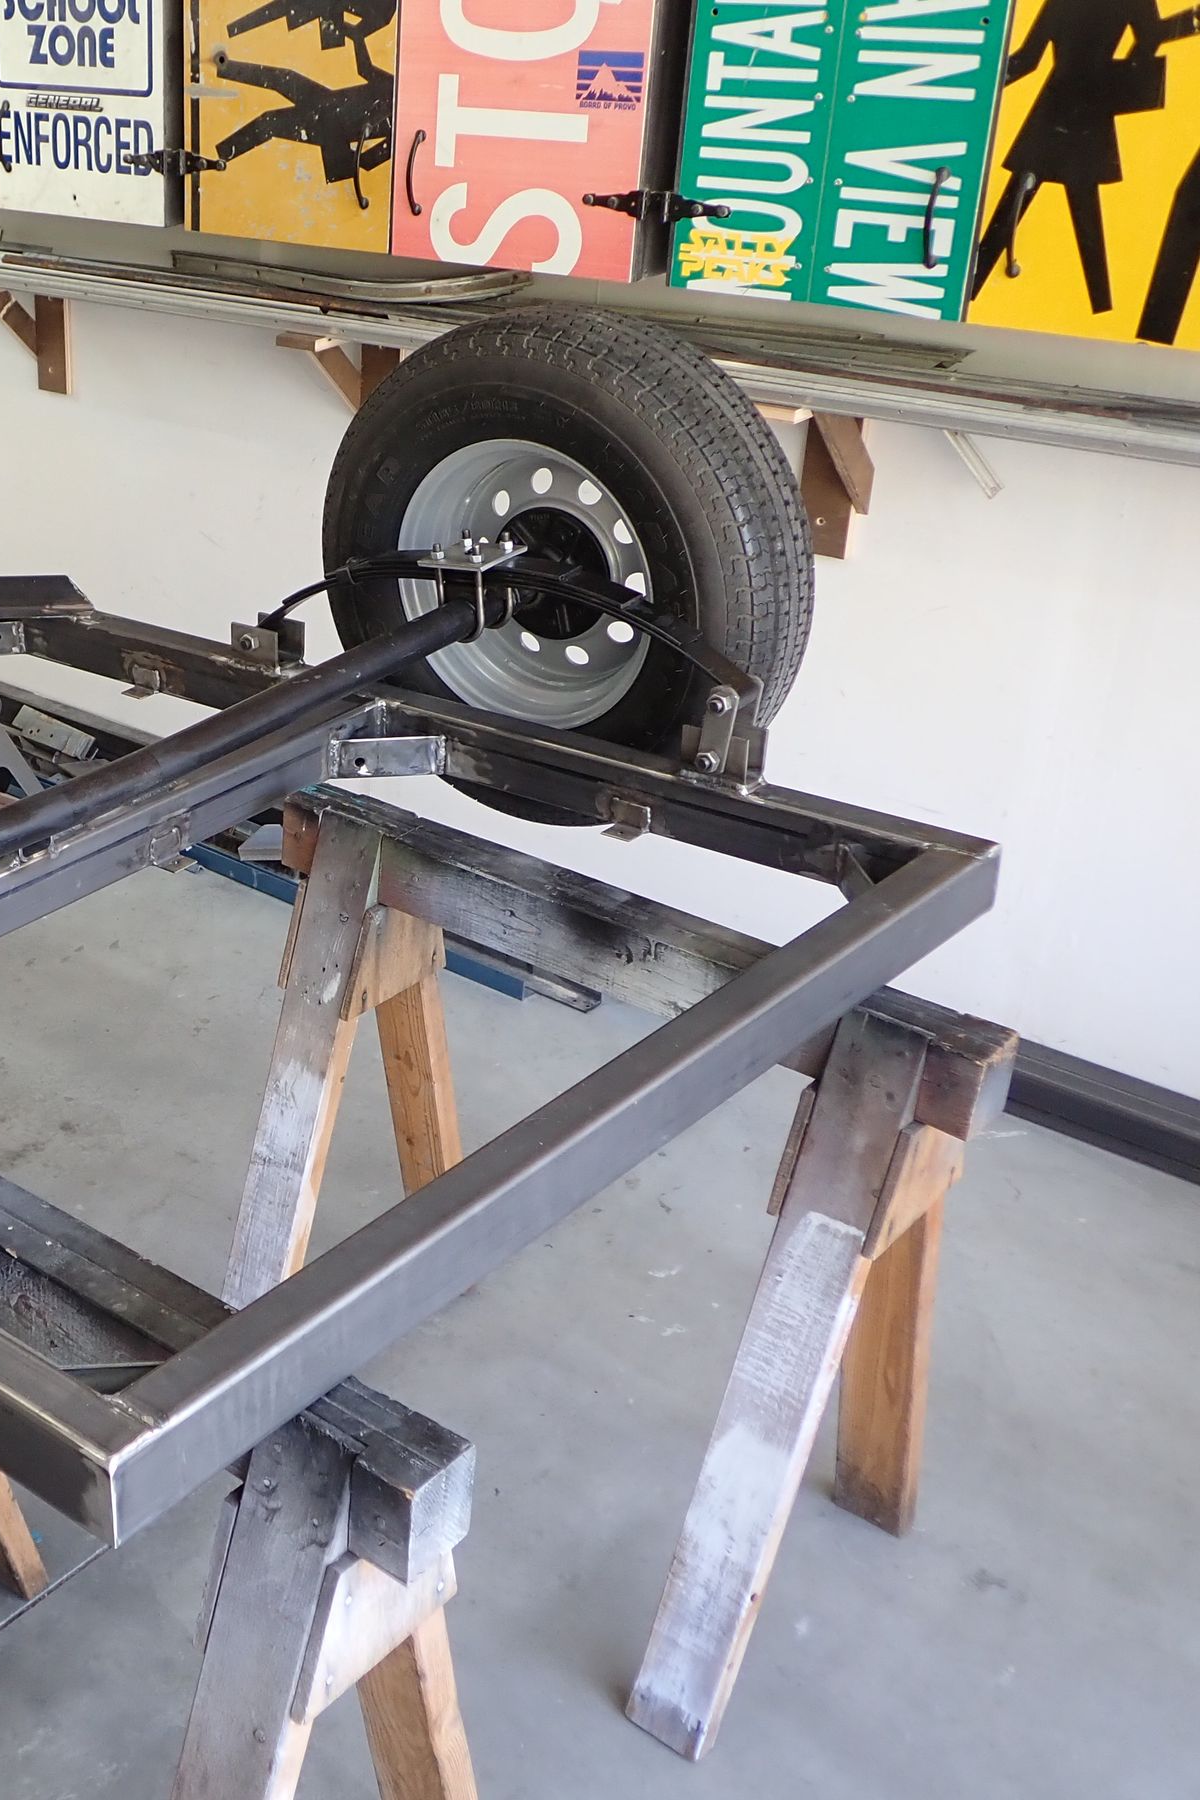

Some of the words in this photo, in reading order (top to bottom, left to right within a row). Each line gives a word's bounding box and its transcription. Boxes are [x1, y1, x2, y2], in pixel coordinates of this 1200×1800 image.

[27, 24, 115, 68] ZONE
[26, 93, 103, 112] GENERAL
[603, 102, 612, 110] OF
[614, 103, 637, 112] PROVO
[827, 141, 968, 320] VIEW
